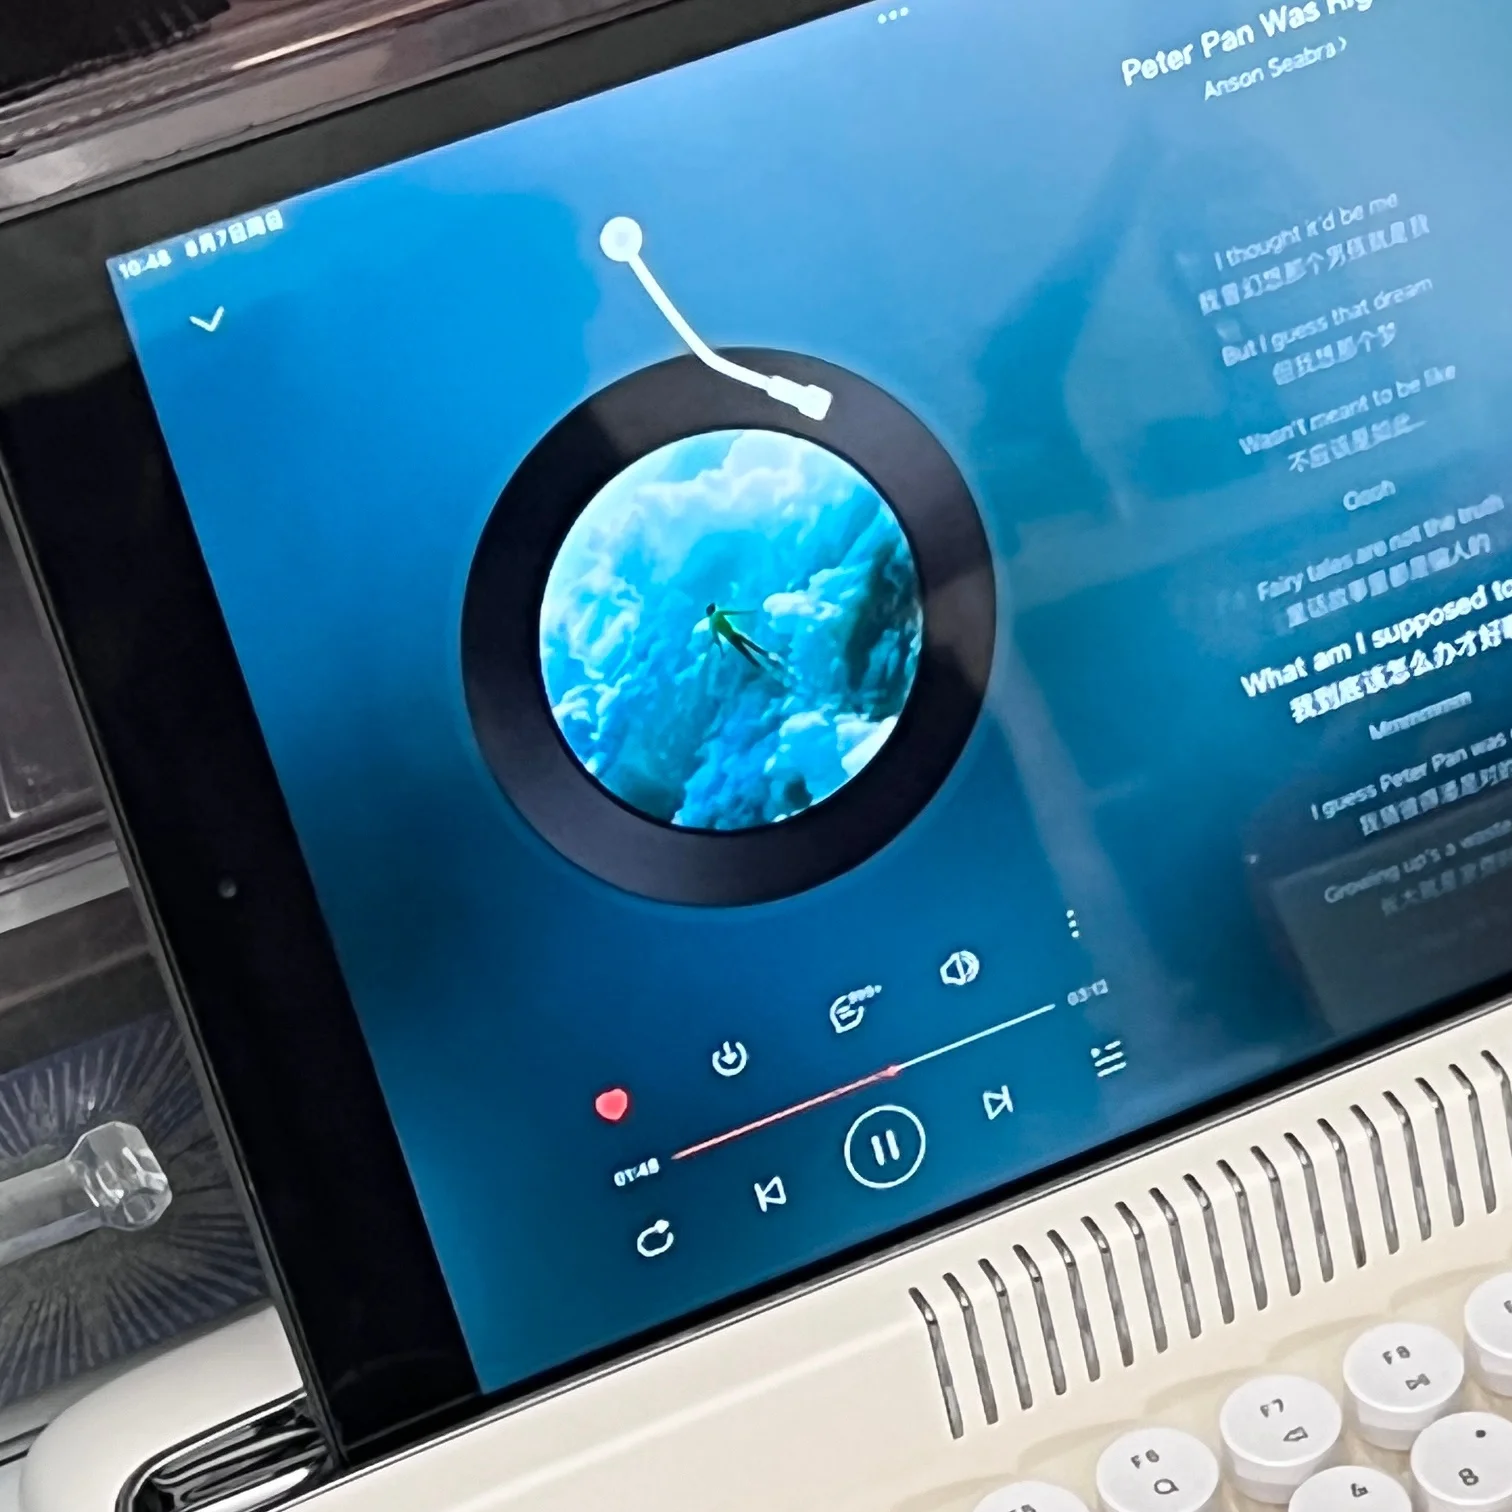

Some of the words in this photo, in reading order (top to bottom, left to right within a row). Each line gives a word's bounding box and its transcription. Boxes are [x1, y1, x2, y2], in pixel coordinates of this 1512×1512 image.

[1121, 43, 1194, 87] Peter
[1200, 24, 1254, 58] Pan
[1258, 1, 1321, 38] Was
[1204, 67, 1265, 101] Anson
[1267, 40, 1337, 79] Seabra
[1226, 226, 1301, 267] thought
[1339, 206, 1364, 227] be
[1369, 193, 1399, 216] me
[1222, 342, 1258, 367] But
[1271, 315, 1328, 352] guess
[1331, 298, 1370, 327] that
[1373, 277, 1434, 311] dream
[1309, 395, 1369, 431] meant
[1371, 388, 1394, 407] to
[1396, 378, 1421, 400] be
[1257, 569, 1304, 602] Fairy
[1240, 655, 1308, 698] What
[1313, 642, 1353, 672] am
[1356, 631, 1367, 655] I
[1371, 584, 1488, 650] supposed
[1432, 745, 1469, 774] Pan
[1458, 1468, 1479, 1486] 8
